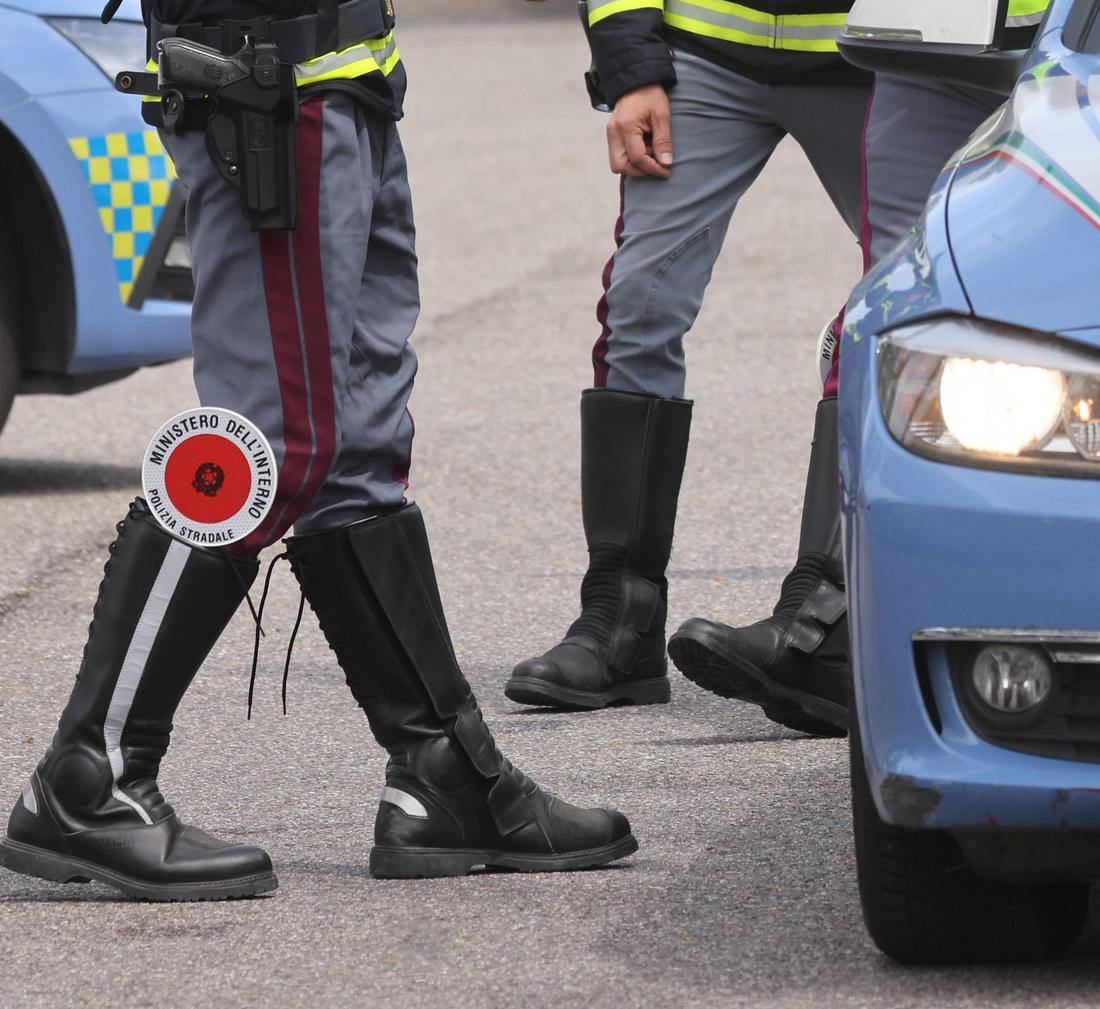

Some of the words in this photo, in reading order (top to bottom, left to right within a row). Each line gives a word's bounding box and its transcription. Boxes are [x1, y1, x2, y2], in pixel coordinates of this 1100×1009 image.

[149, 414, 219, 466] MINISTERO
[226, 419, 272, 520] DELL'INTERNO
[149, 488, 177, 530] POLIZIA
[179, 528, 235, 543] STRADALE
